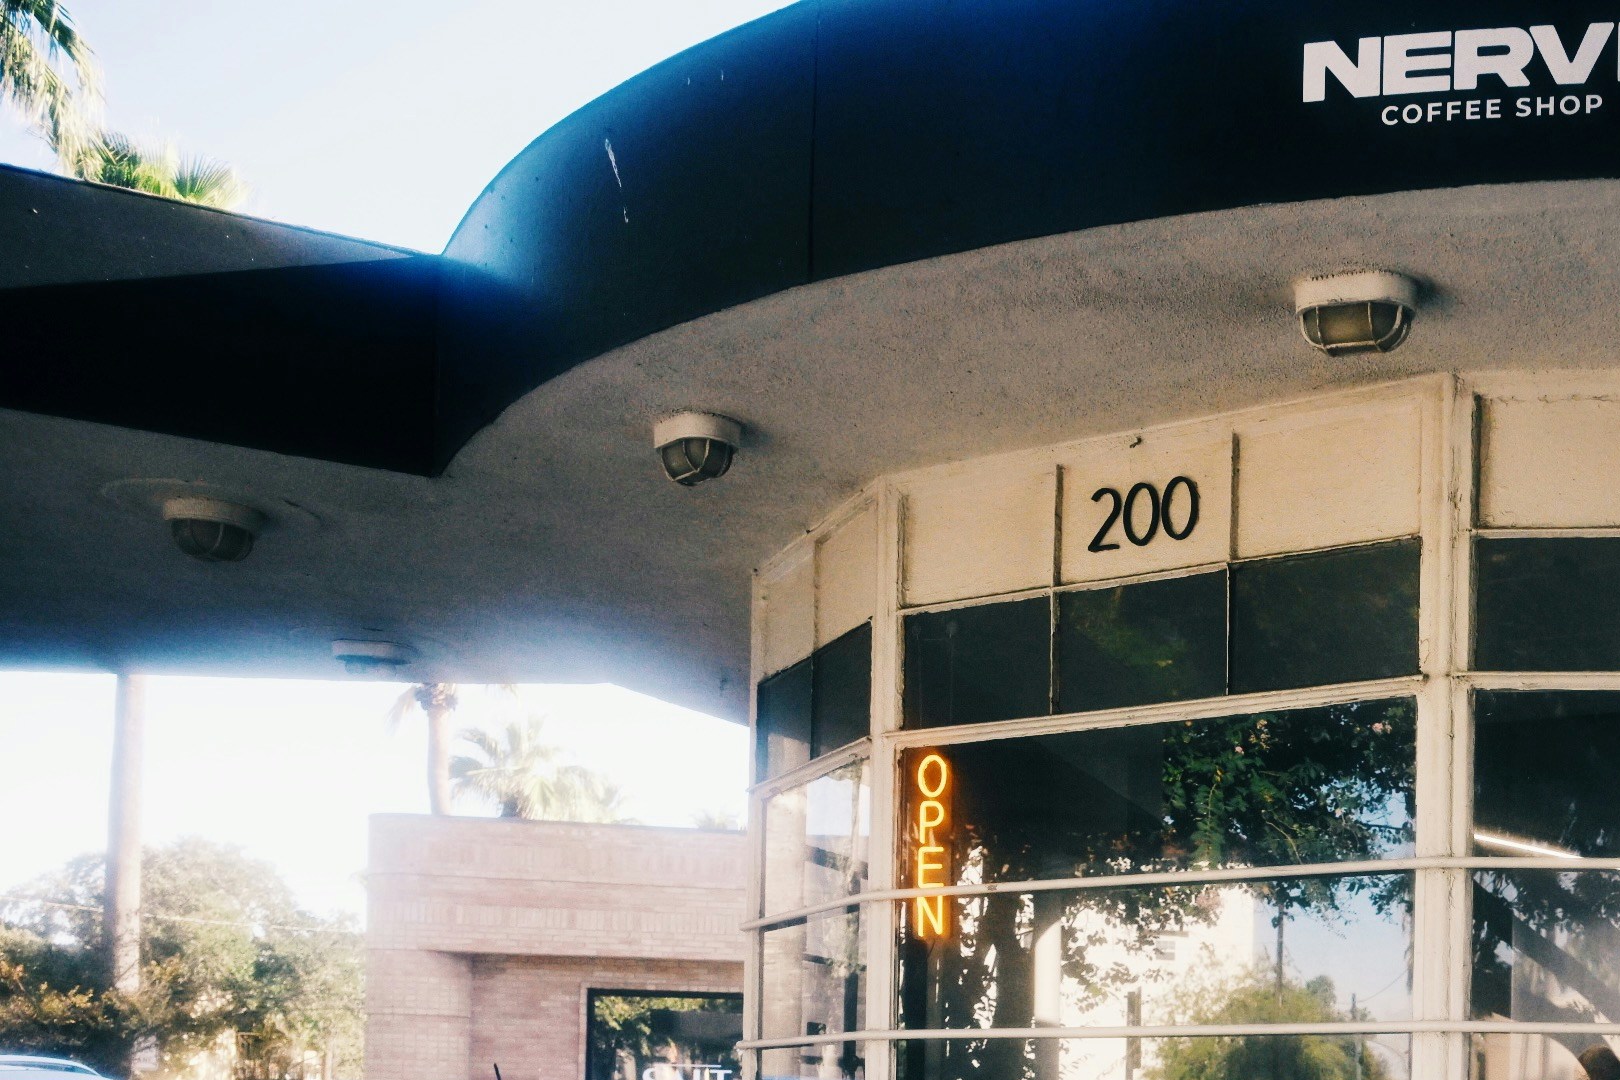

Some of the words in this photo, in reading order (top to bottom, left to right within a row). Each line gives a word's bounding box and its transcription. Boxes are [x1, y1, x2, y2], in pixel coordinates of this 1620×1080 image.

[1381, 99, 1502, 126] COFFEE
[1515, 94, 1603, 118] SHOP
[1088, 476, 1200, 552] 200
[917, 754, 947, 937] OPEN
